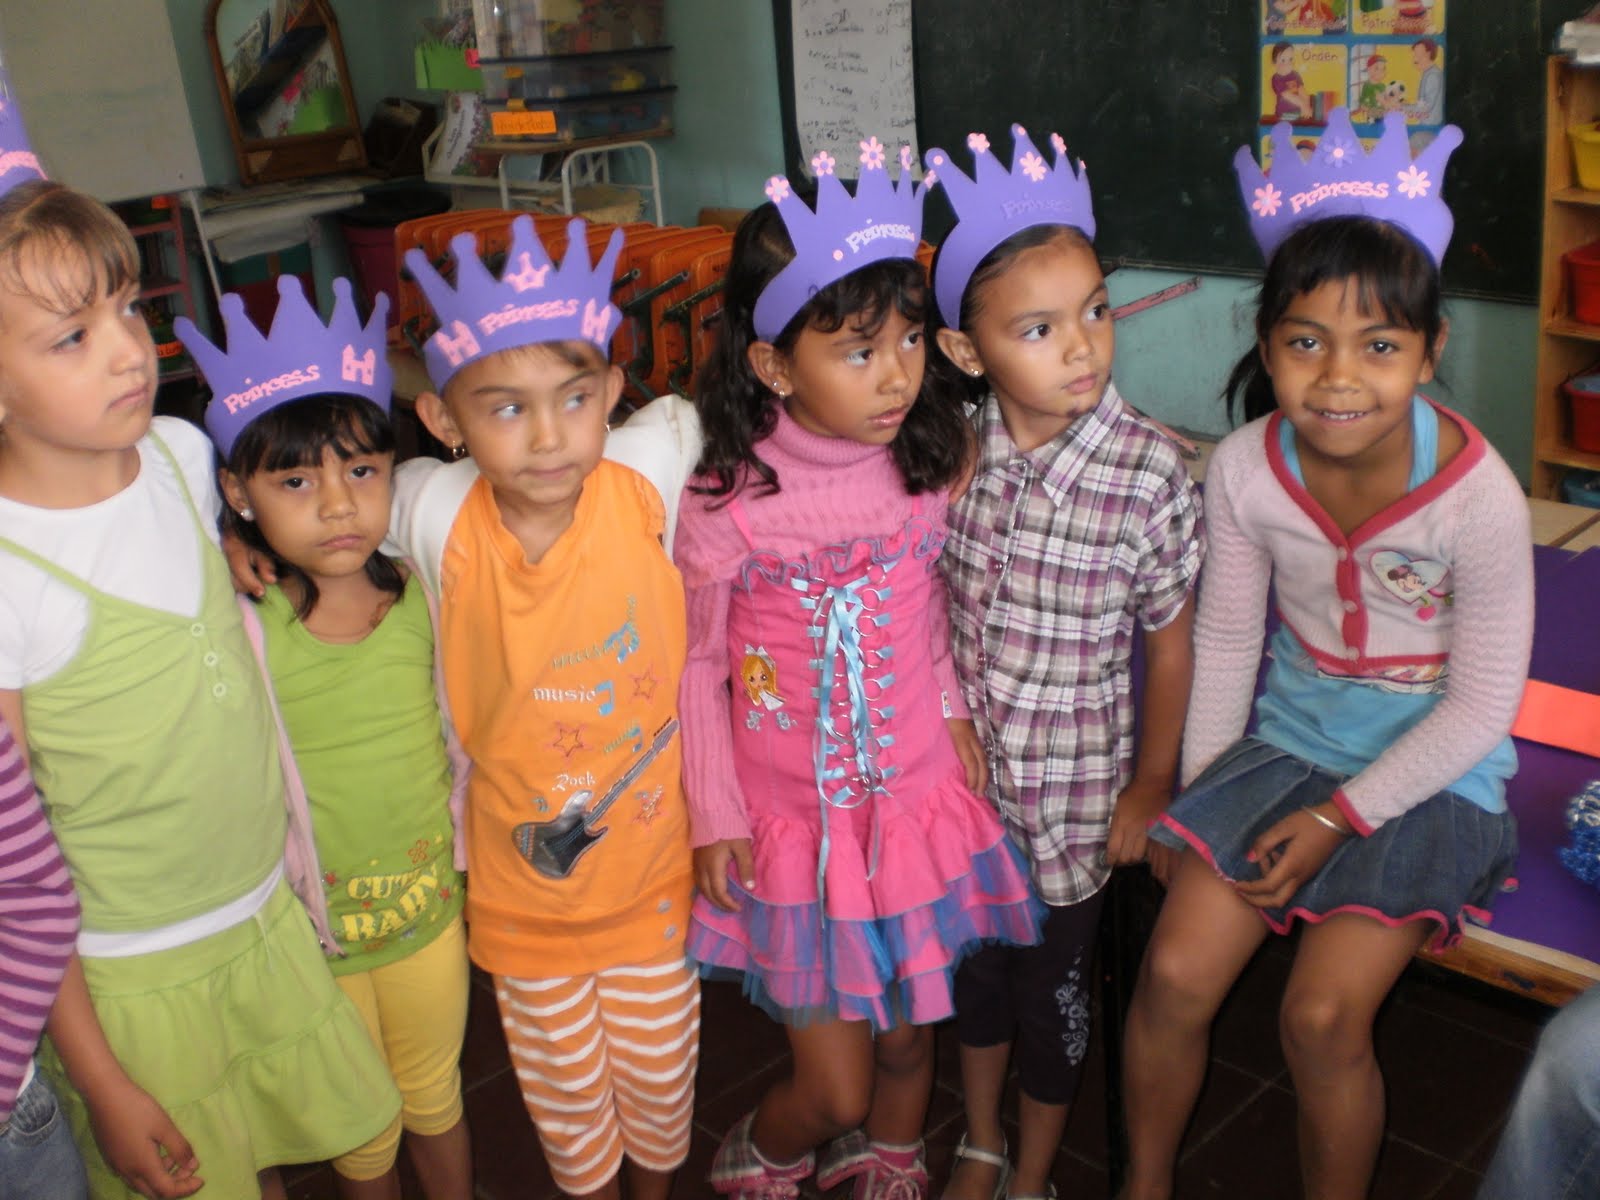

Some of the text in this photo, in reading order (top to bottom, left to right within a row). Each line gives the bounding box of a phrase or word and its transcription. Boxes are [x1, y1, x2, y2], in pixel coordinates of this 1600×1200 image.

[1302, 49, 1338, 61] Orden
[1289, 181, 1390, 215] Princess
[845, 217, 916, 254] Princess
[477, 298, 580, 337] Princess
[223, 363, 321, 415] Princess
[533, 685, 597, 703] music
[551, 769, 597, 792] Rock
[347, 870, 420, 899] CUT
